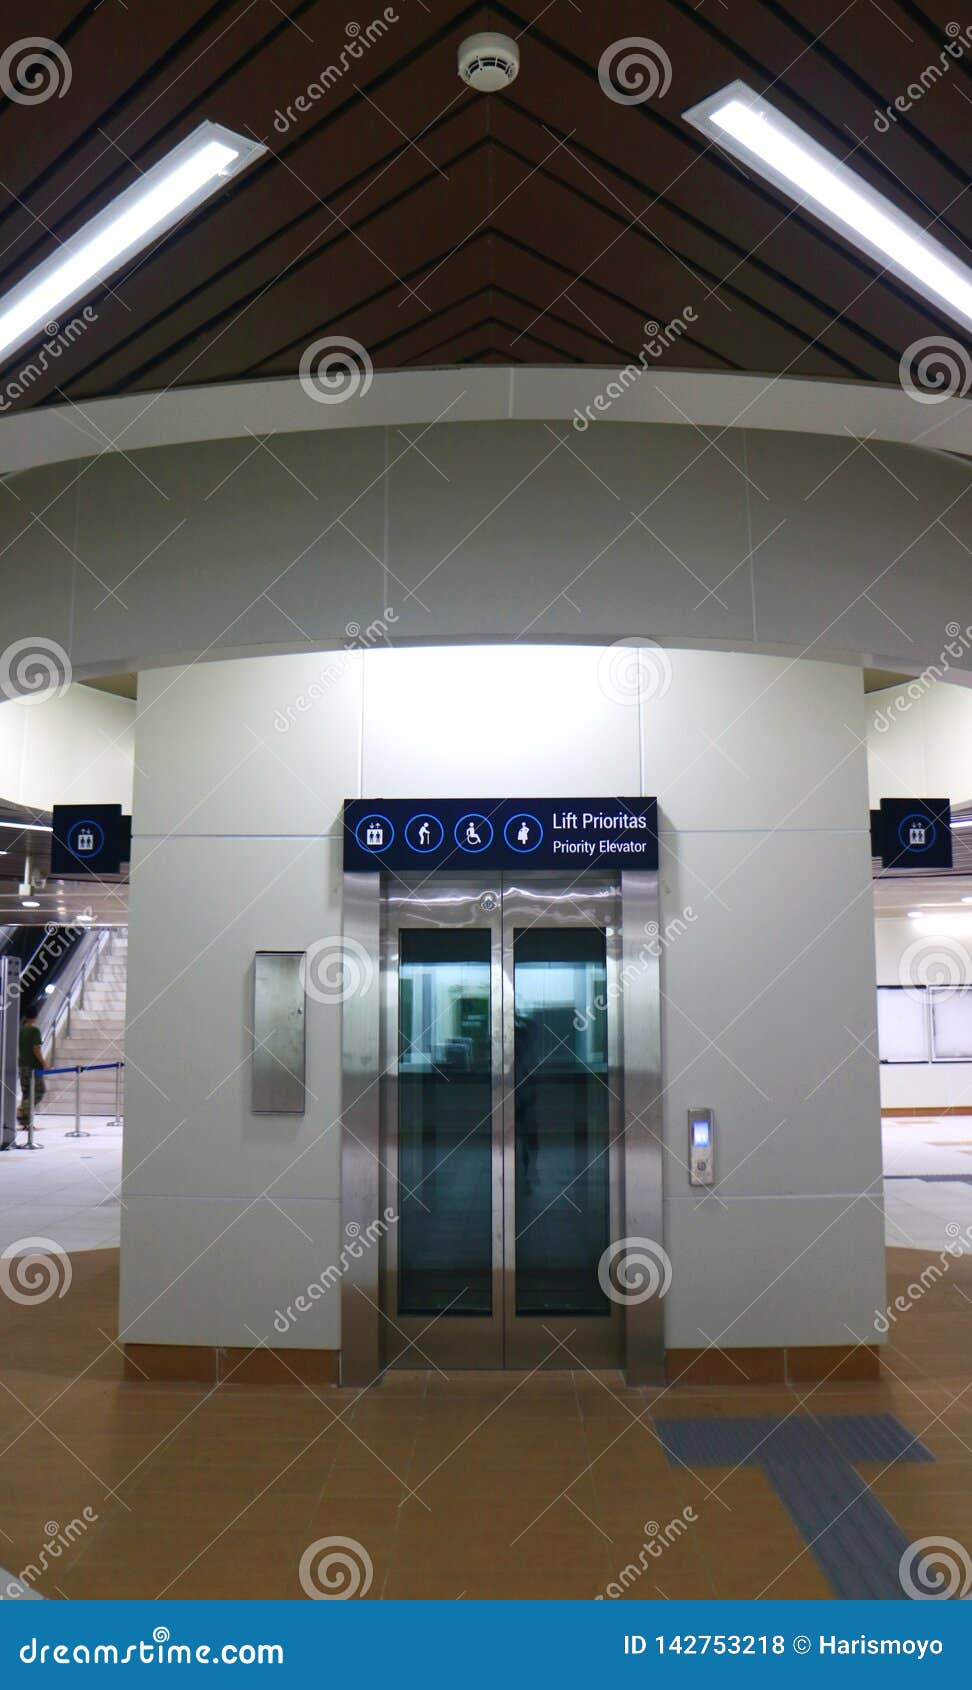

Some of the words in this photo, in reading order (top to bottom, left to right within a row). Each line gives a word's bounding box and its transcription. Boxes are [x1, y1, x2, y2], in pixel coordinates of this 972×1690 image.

[553, 812, 577, 829] Lift
[583, 812, 647, 829] Prioritas
[553, 839, 595, 856] Priority
[599, 839, 647, 853] Elevator
